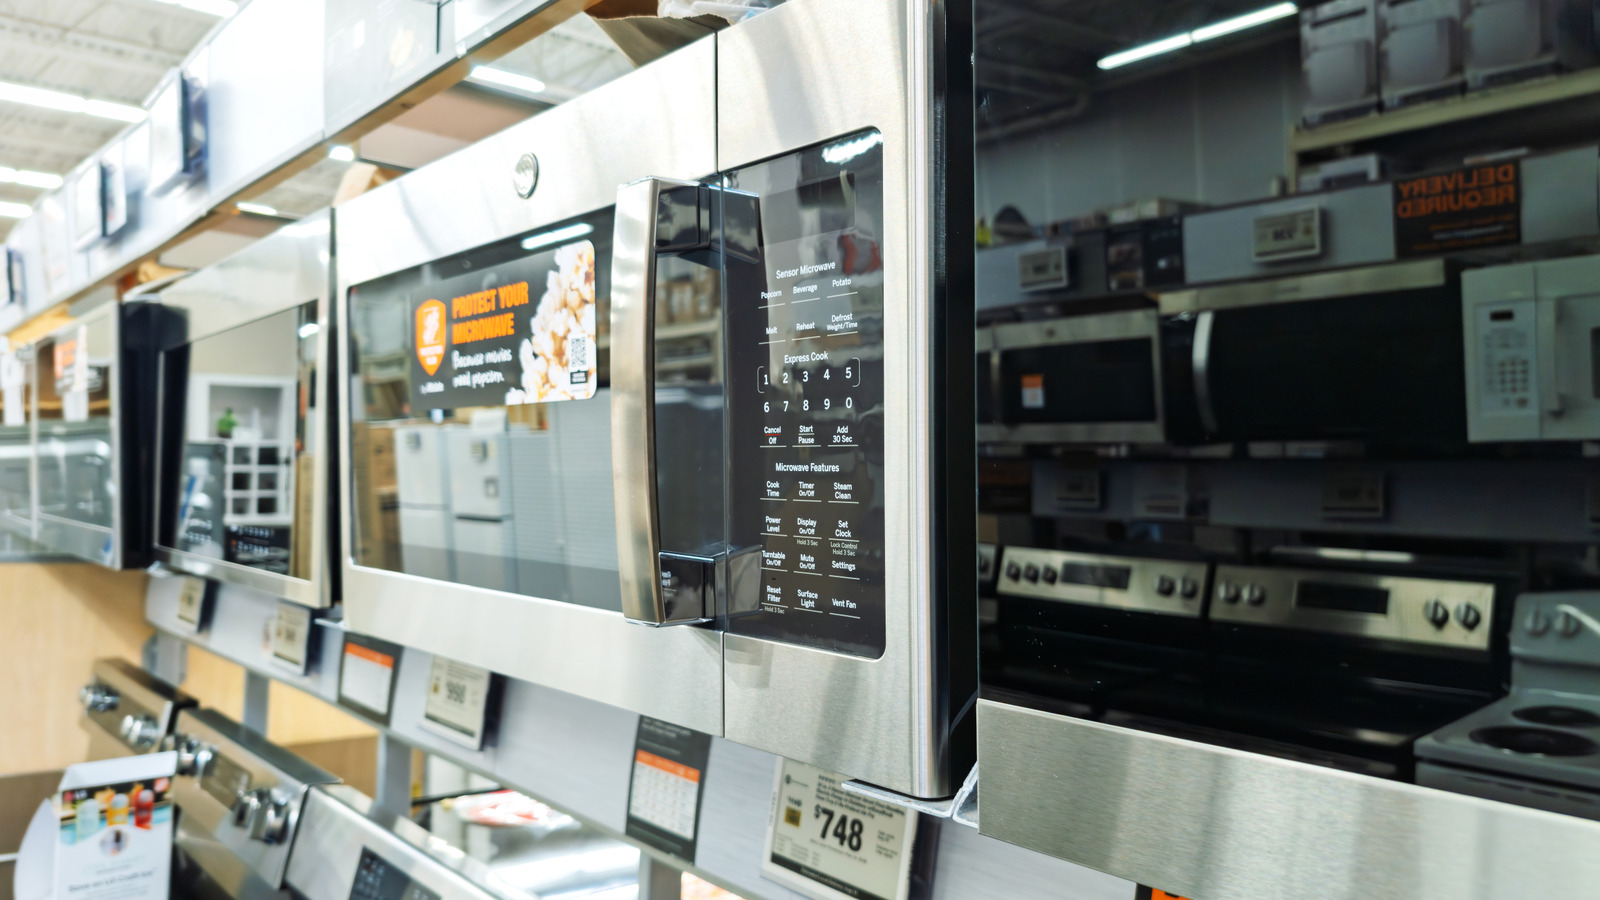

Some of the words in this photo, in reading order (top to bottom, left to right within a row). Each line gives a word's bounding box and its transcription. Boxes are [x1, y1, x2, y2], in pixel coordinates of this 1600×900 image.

[776, 269, 798, 279] Sensor
[800, 261, 836, 275] Microwave
[832, 278, 851, 287] Potato
[793, 284, 818, 294] Beverage
[761, 290, 782, 299] Popcorn
[452, 288, 497, 319] PROTECT
[498, 280, 528, 309] YOUR
[831, 313, 852, 322] Defrost
[452, 312, 514, 345] MICROWAVE
[796, 322, 815, 331] Reheat
[827, 322, 858, 331] Weight/Time
[452, 350, 484, 370] Because
[784, 354, 809, 364] Express
[811, 351, 828, 361] Cook
[764, 374, 768, 385] 1
[783, 372, 788, 384] 2
[803, 371, 808, 382] 3
[824, 369, 830, 380] 4
[846, 367, 852, 378] 5
[764, 402, 770, 413] 6
[783, 401, 788, 412] 7
[803, 400, 809, 411] 8
[824, 398, 830, 410] 9
[846, 397, 852, 408] 0
[842, 435, 852, 443] Sec
[776, 463, 809, 472] Microwave
[810, 463, 839, 472] Features
[834, 482, 852, 490] Steam
[797, 518, 817, 527] Display
[838, 520, 848, 528] Set
[835, 529, 851, 537] Clock
[762, 550, 785, 559] Turntable
[800, 554, 814, 562] Mute
[832, 560, 856, 571] Settings
[767, 585, 781, 594] Reset
[798, 589, 818, 599] Surface
[768, 594, 780, 602] Filter
[801, 599, 815, 608] Light
[832, 598, 845, 607] Vent
[846, 600, 856, 609] Fan
[814, 804, 864, 852] $748
